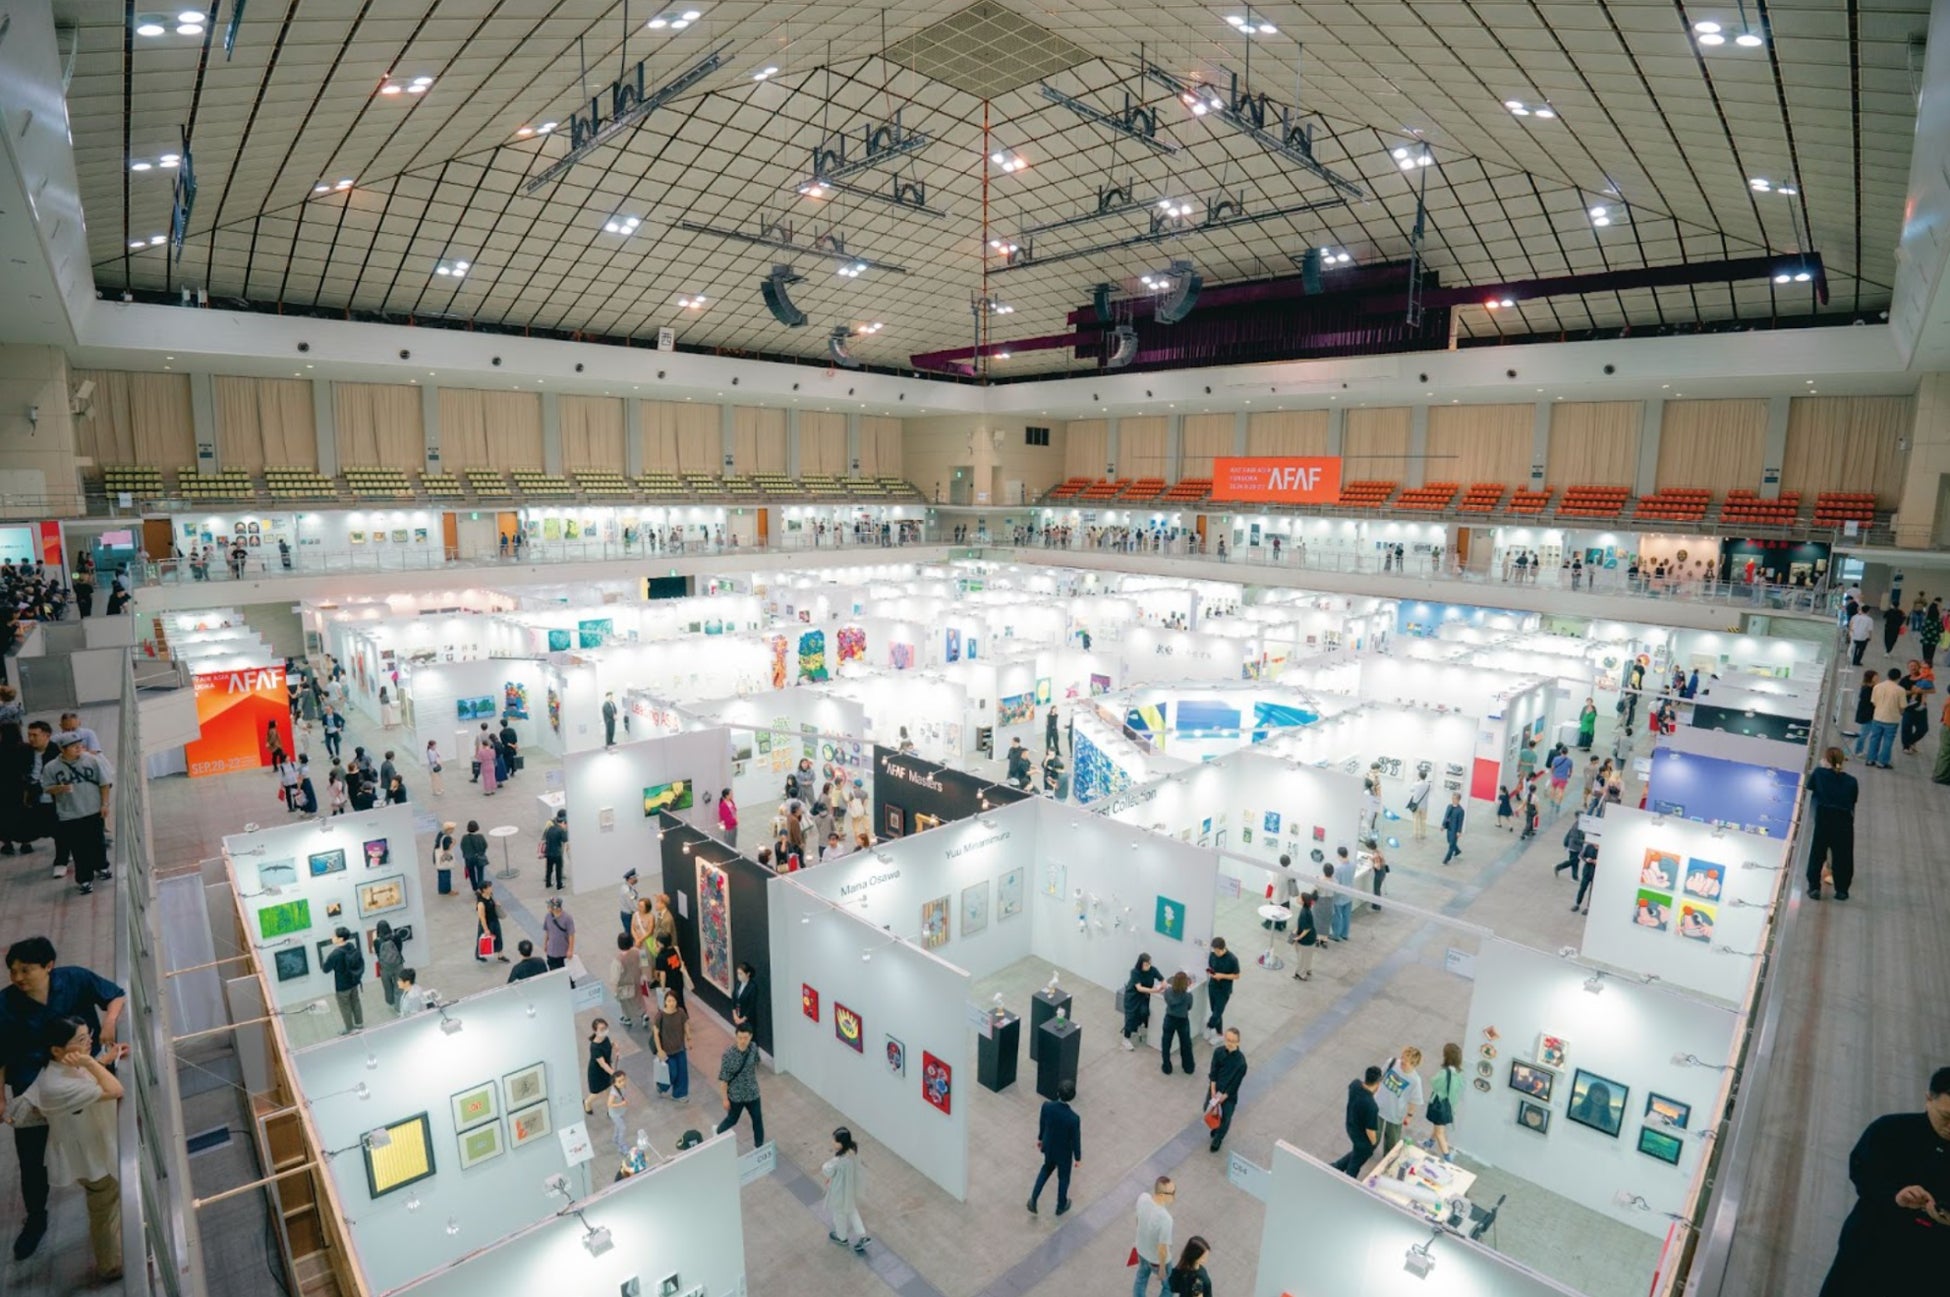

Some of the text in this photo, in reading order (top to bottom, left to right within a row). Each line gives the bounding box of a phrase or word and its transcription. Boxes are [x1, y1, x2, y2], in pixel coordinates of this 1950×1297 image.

[1267, 467, 1322, 491] AFAF
[228, 668, 284, 695] AFAF
[945, 848, 962, 861] Yuu
[840, 869, 901, 897] Mana Osawa
